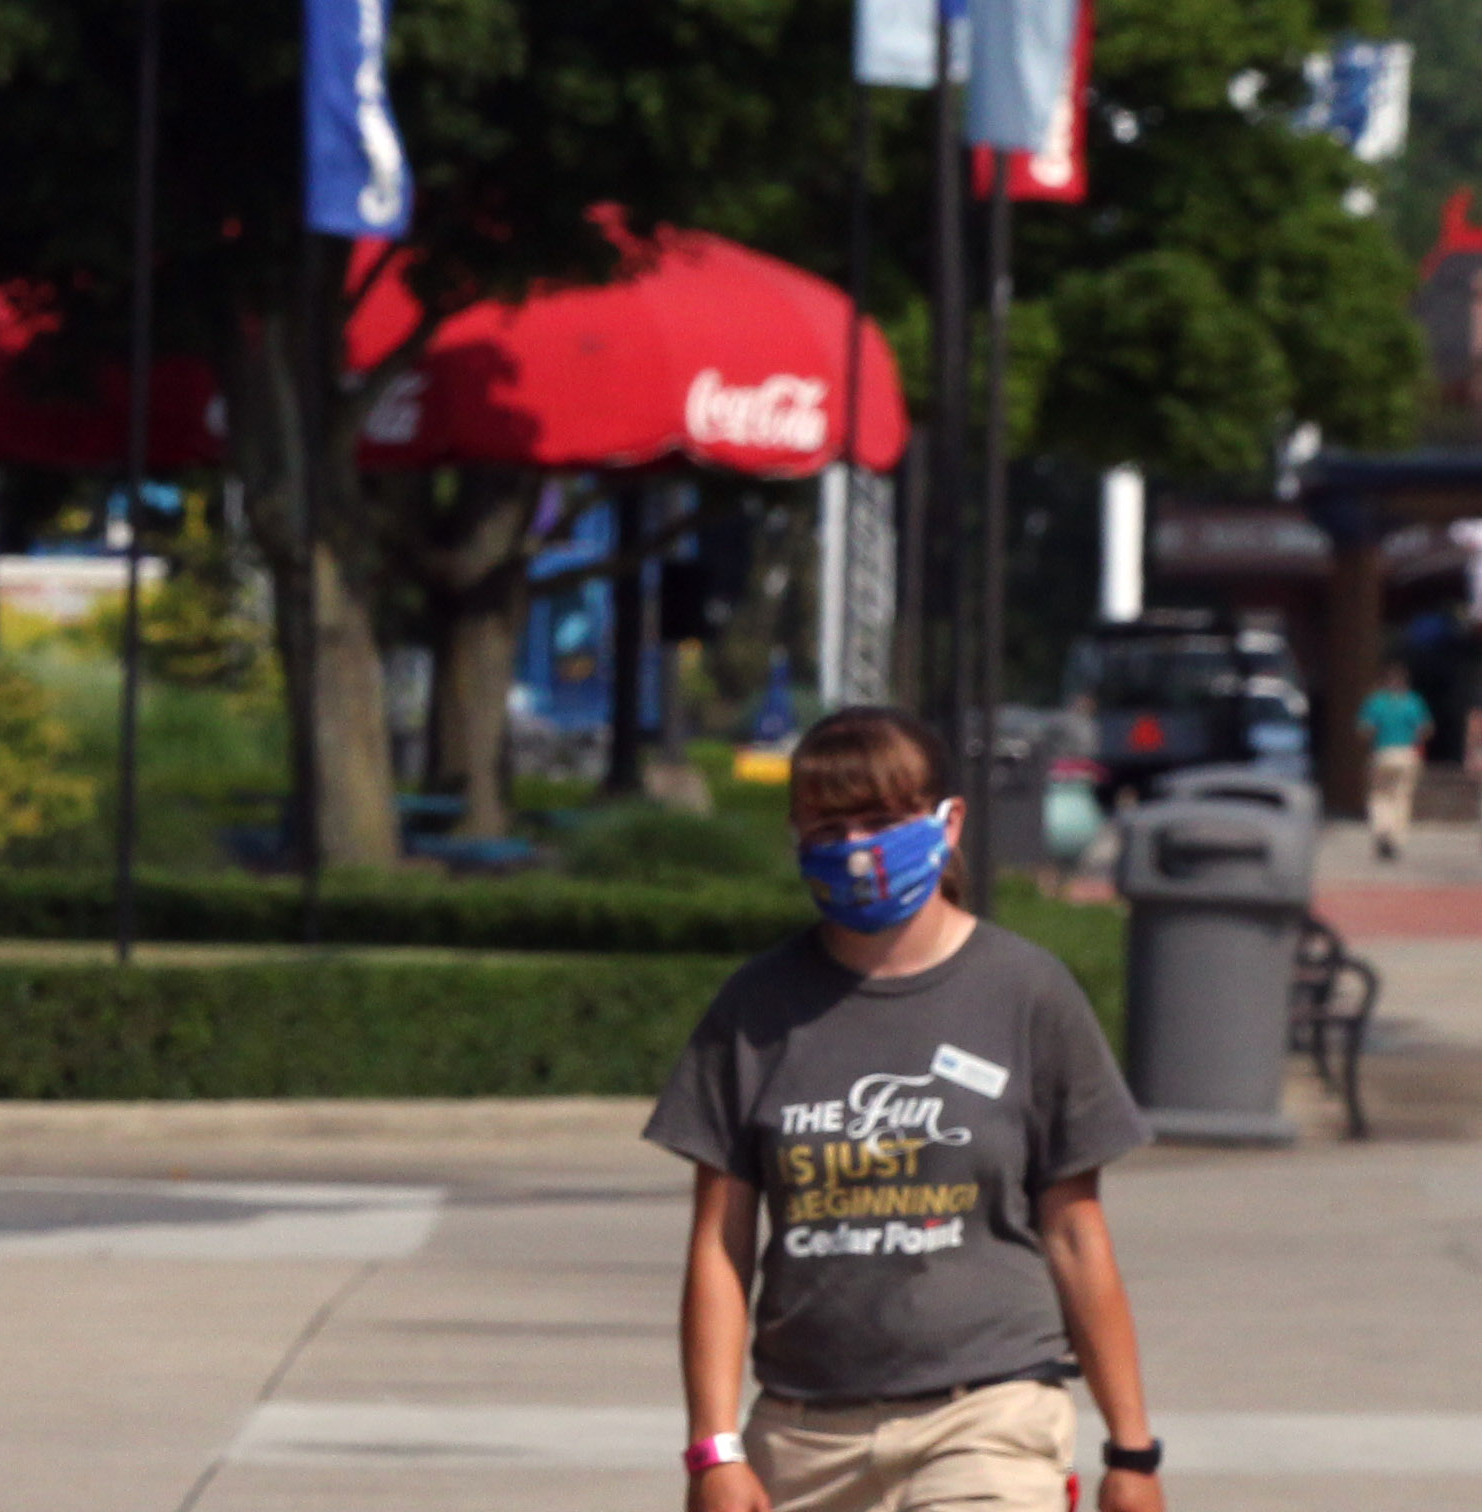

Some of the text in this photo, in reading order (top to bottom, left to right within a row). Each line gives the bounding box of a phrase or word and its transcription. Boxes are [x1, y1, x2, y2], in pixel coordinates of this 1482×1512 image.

[781, 1073, 972, 1145] THE Fun
[823, 1138, 926, 1187] JUST
[785, 1215, 965, 1258] Cedar Point
